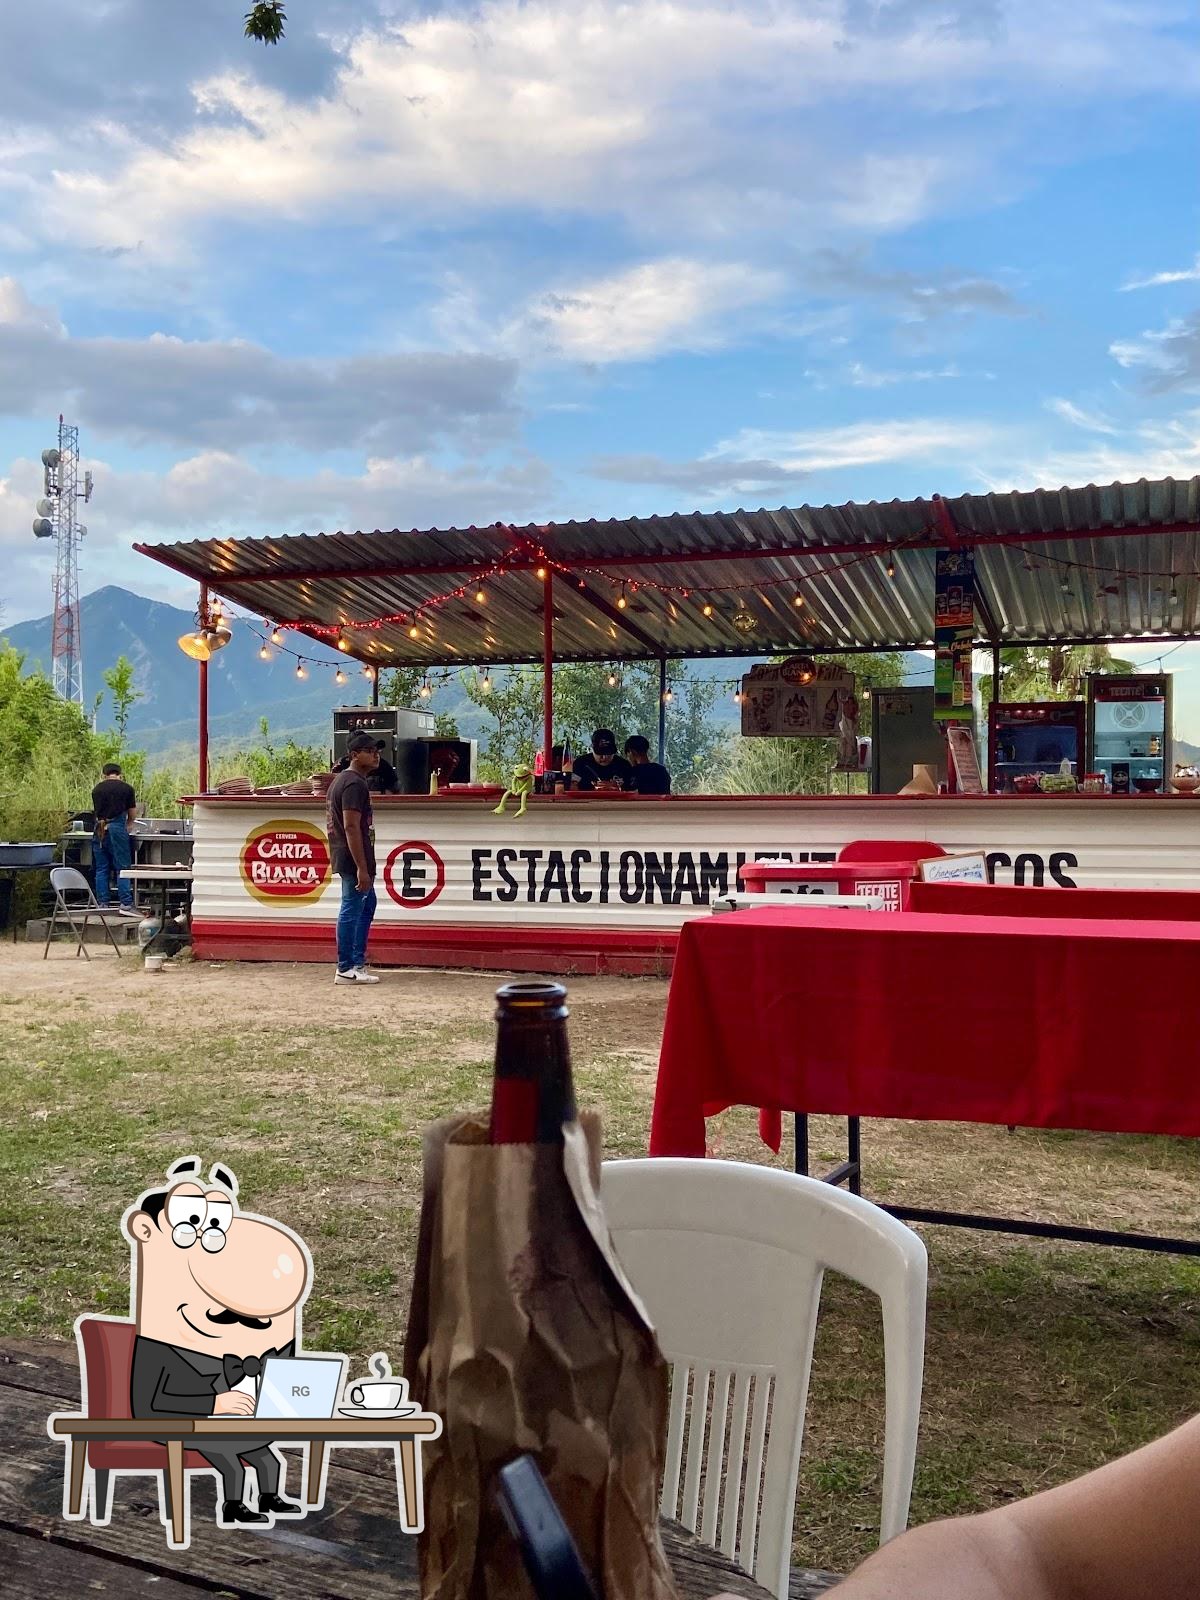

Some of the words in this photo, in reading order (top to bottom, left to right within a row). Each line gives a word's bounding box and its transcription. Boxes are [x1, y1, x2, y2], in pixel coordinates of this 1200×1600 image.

[1110, 686, 1143, 696] TECATE
[257, 838, 313, 859] CARTA
[251, 860, 321, 885] BLANCA
[402, 852, 427, 897] E
[471, 848, 837, 906] ESTACIONAMI
[857, 883, 900, 899] TECATE
